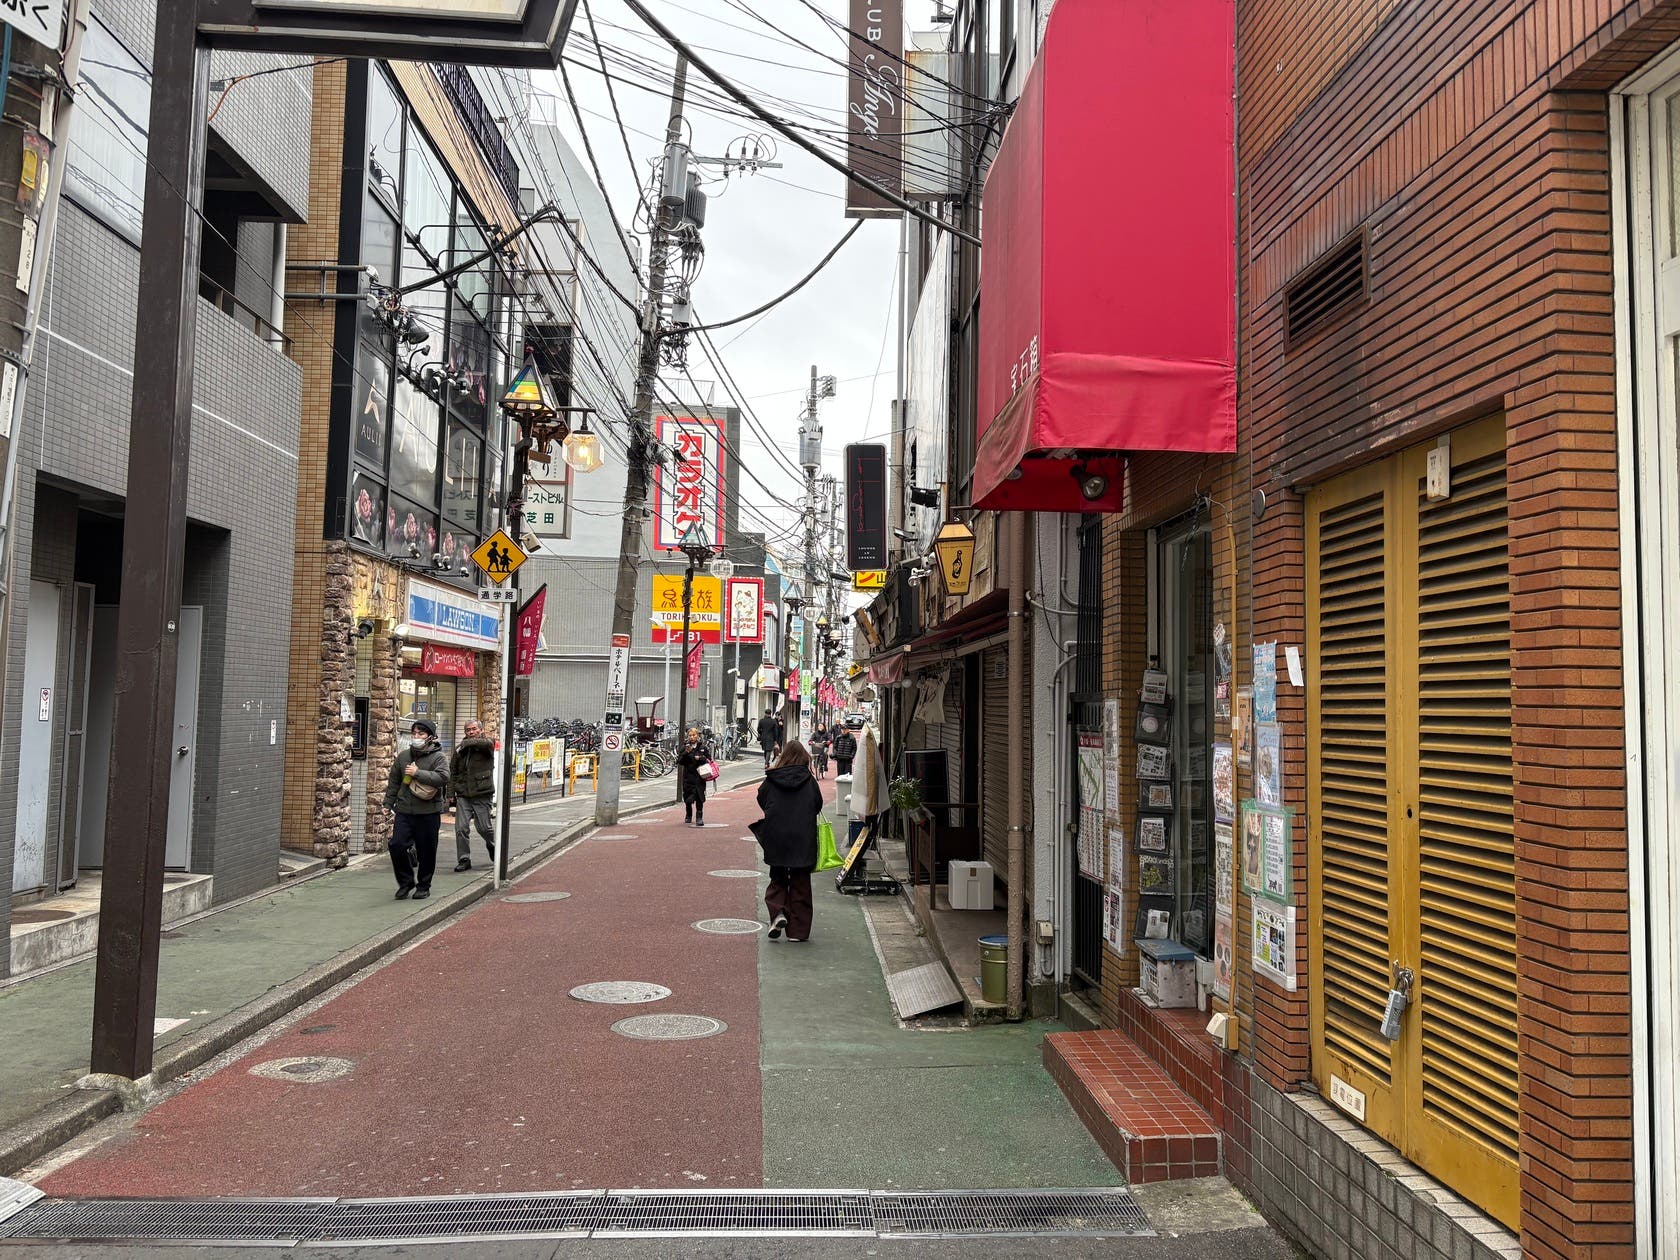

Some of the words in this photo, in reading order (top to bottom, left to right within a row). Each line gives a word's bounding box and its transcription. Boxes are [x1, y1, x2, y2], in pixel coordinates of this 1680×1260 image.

[866, 0, 882, 41] UB
[481, 591, 514, 600] 通学路
[661, 589, 713, 609] 鳥族
[442, 606, 475, 632] LAWSON
